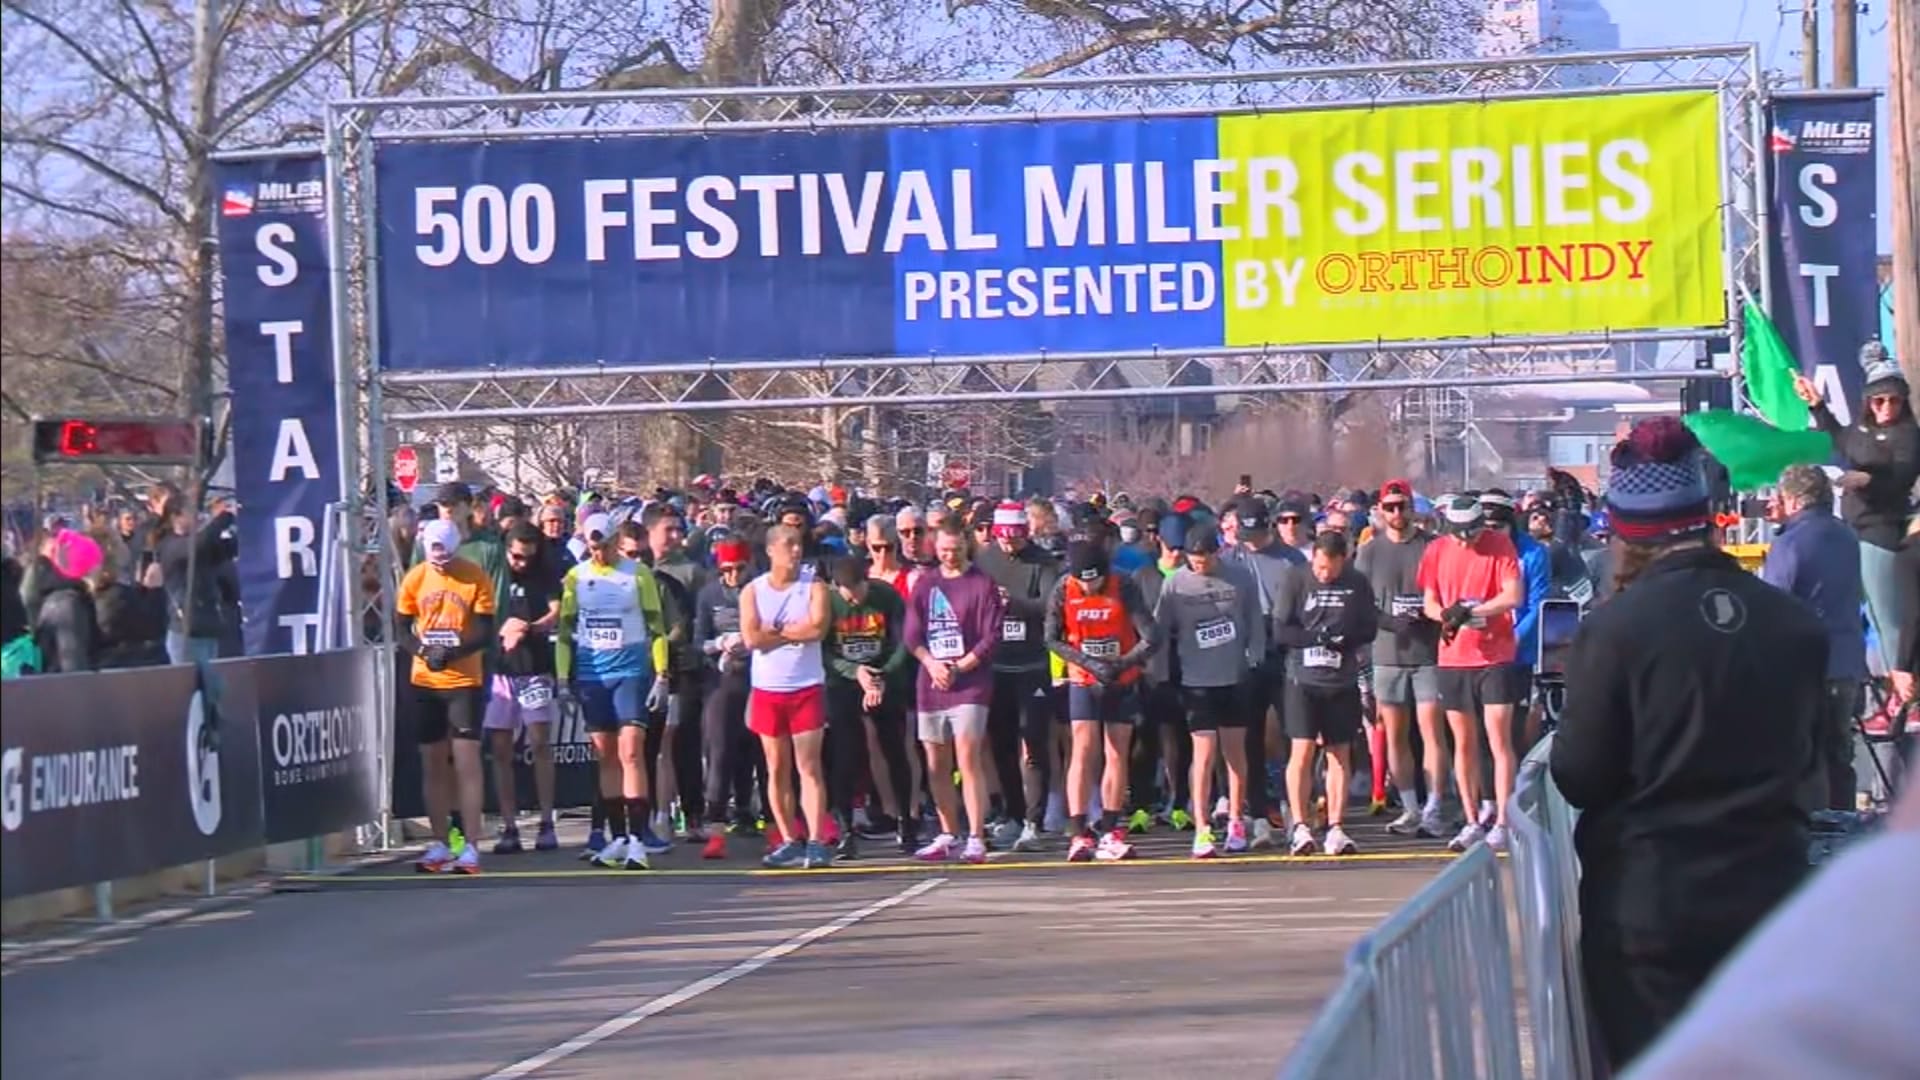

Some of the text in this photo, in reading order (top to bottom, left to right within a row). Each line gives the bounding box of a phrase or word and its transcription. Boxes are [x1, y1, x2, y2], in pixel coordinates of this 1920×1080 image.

[1802, 121, 1872, 138] MILER
[258, 180, 323, 200] MILER
[415, 138, 1653, 267] 500 FESTIVAL MILER SERIES
[904, 262, 1216, 323] PRESENTED
[1235, 258, 1305, 310] BY
[1315, 240, 1653, 295] ORTHOINDY
[254, 222, 322, 655] START
[272, 706, 370, 767] ORTHOI
[30, 745, 139, 812] ENDURANCE
